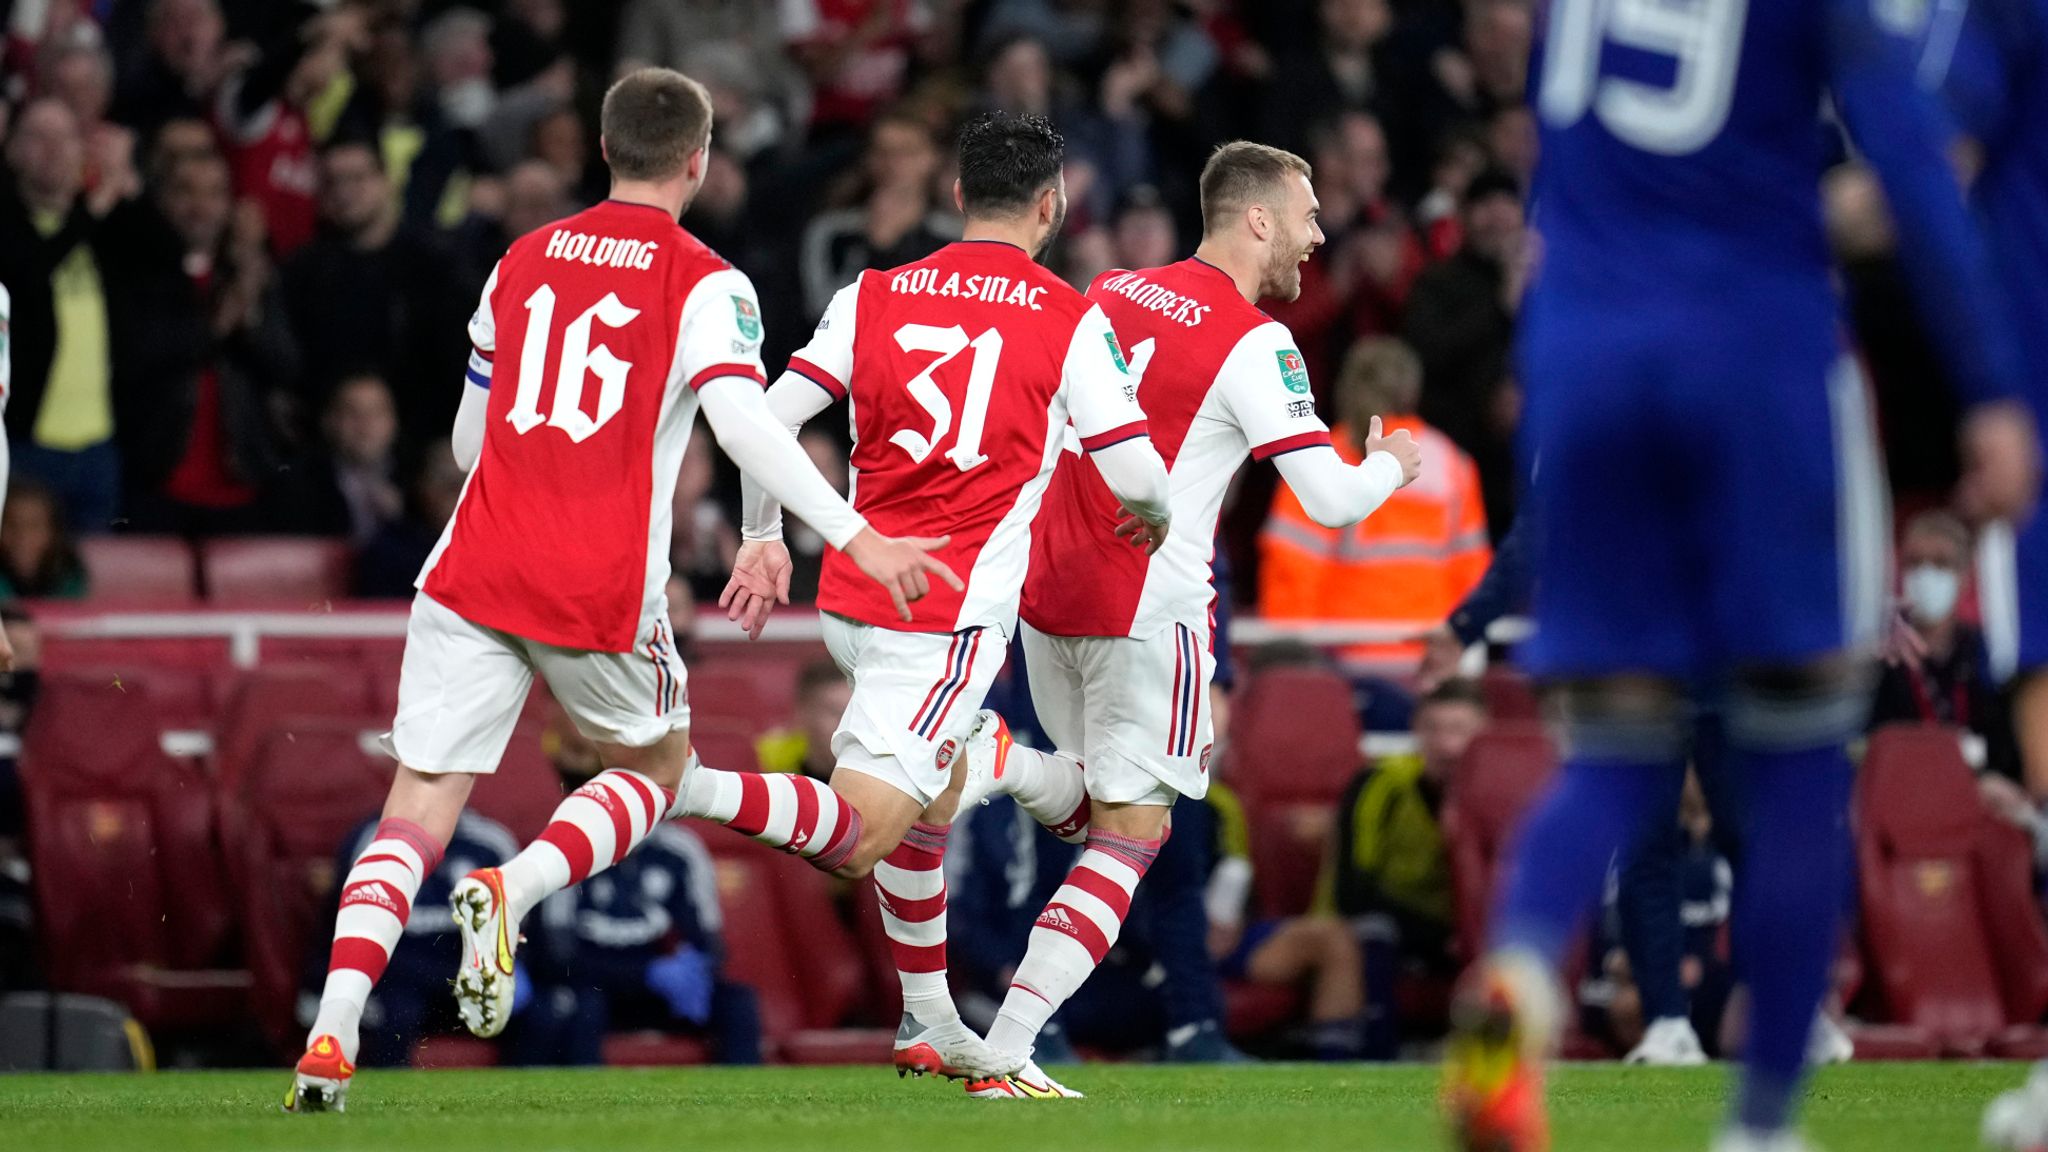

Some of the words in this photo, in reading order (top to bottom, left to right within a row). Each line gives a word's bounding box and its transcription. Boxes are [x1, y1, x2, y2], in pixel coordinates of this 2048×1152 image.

[1537, 0, 1748, 156] 19
[545, 229, 659, 271] HOLDING
[890, 267, 1048, 311] KOLASINAC
[1102, 273, 1211, 327] CHAMBERS
[505, 283, 641, 443] 16
[888, 323, 1004, 472] 31
[345, 893, 398, 911] adidas
